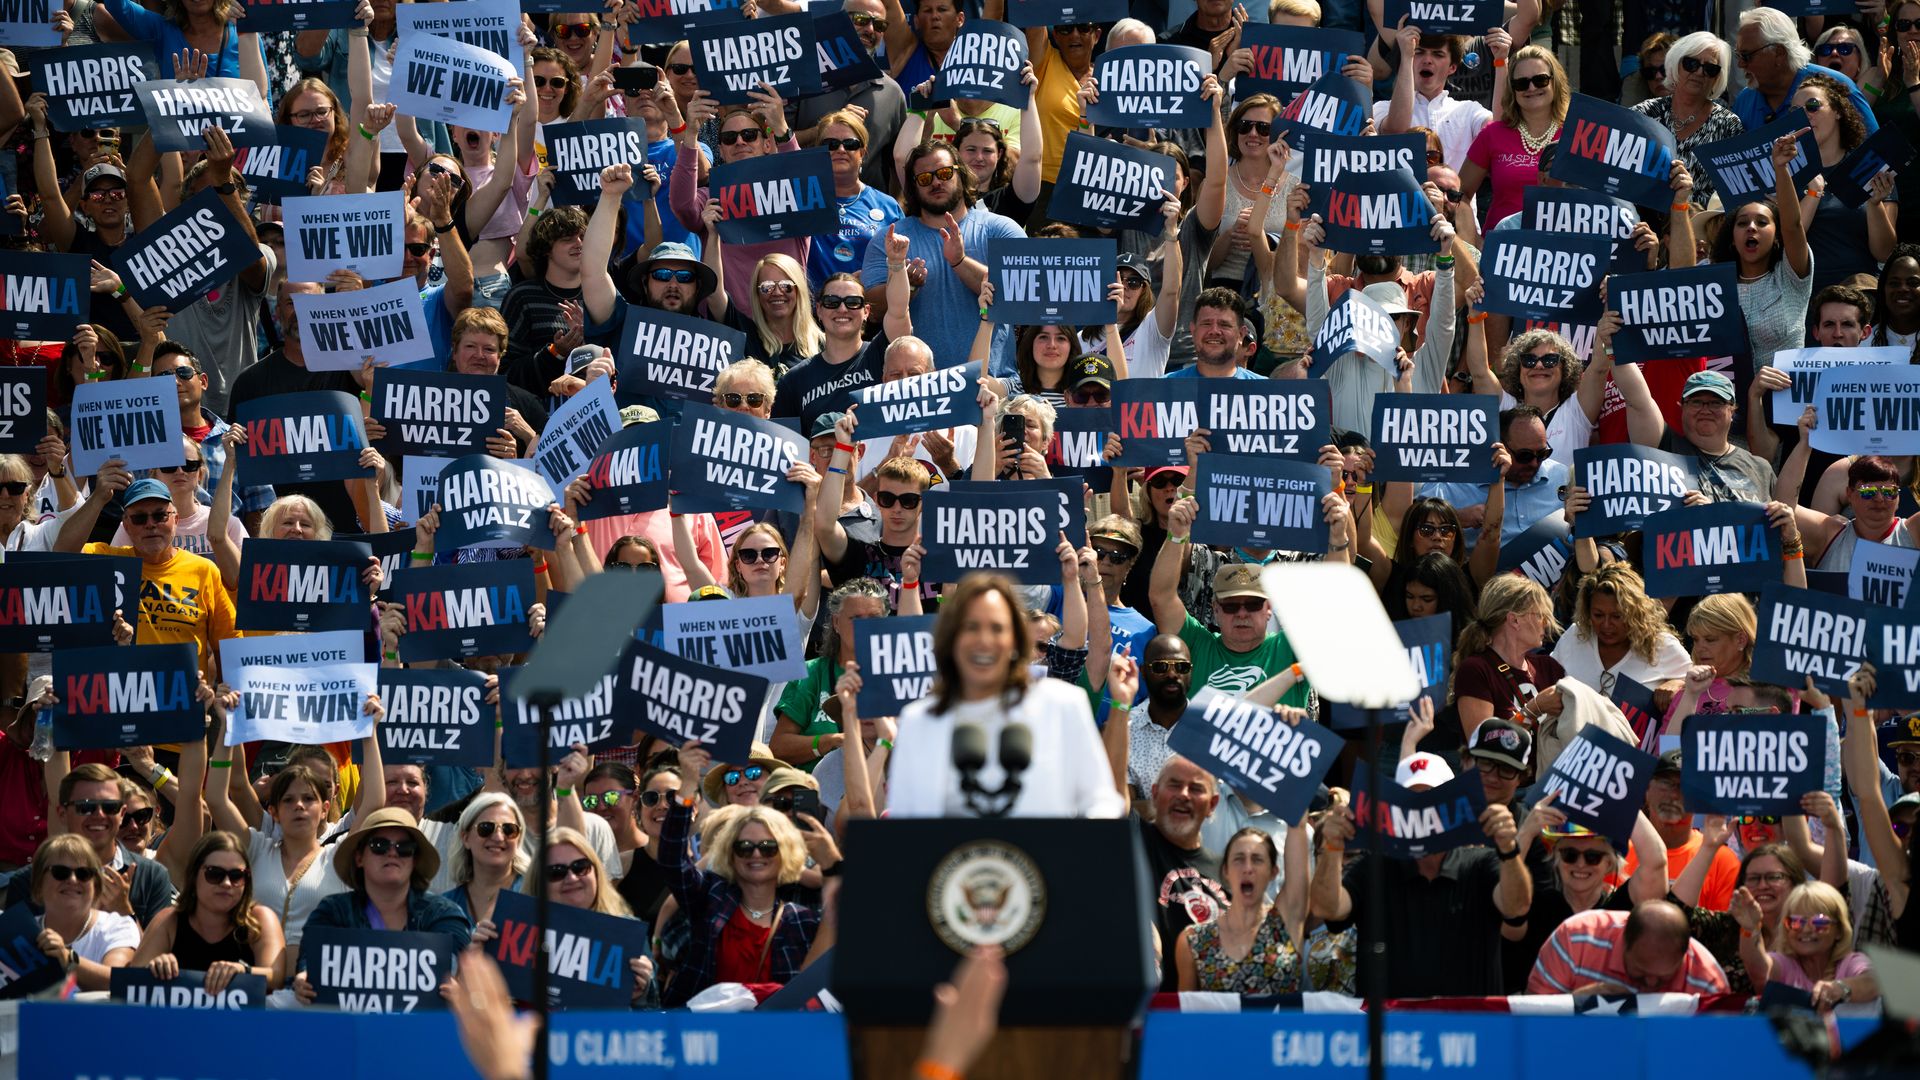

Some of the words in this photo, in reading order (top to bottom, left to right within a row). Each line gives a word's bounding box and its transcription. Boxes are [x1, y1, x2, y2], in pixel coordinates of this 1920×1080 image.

[413, 19, 449, 30] WHEN
[452, 18, 471, 28] WE
[474, 16, 504, 27] VOTE
[1411, 2, 1475, 22] WALZ
[414, 49, 448, 64] WHEN
[449, 56, 471, 70] WE
[474, 62, 504, 76] VOTE
[702, 26, 802, 72] HARRIS
[940, 32, 1021, 72] HARRIS
[44, 56, 146, 97] HARRIS
[406, 61, 451, 96] WE
[452, 71, 504, 111] WIN
[724, 65, 791, 92] WALZ
[945, 66, 1004, 90] WALZ
[1100, 59, 1200, 92] HARRIS
[66, 94, 135, 117] WALZ
[151, 87, 254, 116] HARRIS
[1117, 96, 1184, 114] WALZ
[554, 130, 642, 172] HARRIS
[1314, 148, 1414, 183] HARRIS
[1569, 118, 1670, 180] KAMALA
[1711, 150, 1739, 166] WHEN
[1740, 142, 1765, 157] WE
[572, 172, 601, 191] WA
[1072, 150, 1164, 201] HARRIS
[1717, 160, 1752, 196] WE
[302, 211, 340, 224] WHEN
[343, 210, 362, 222] WE
[364, 209, 391, 222] VOTE
[719, 174, 826, 222] KAMALA
[1082, 190, 1146, 217] WALZ
[1328, 190, 1428, 230] KAMALA
[1536, 201, 1634, 239] HARRIS
[126, 208, 226, 291] HARRIS
[300, 228, 341, 260] WE
[345, 222, 393, 257] WIN
[160, 247, 228, 300] WALZ
[1002, 256, 1040, 266] WHEN
[1042, 256, 1062, 266] WE
[1064, 256, 1101, 266] FIGHT
[1494, 242, 1596, 289] HARRIS
[0, 274, 80, 316] MALA
[1001, 269, 1040, 302] WE
[1046, 269, 1101, 302] WIN
[1508, 282, 1575, 309] WALZ
[1620, 282, 1726, 326] HARRIS
[309, 307, 346, 320] WHEN
[348, 305, 371, 318] WE
[373, 298, 404, 313] VOTE
[1317, 299, 1395, 350] HARRIS
[310, 322, 353, 352] WE
[356, 311, 414, 350] WIN
[633, 322, 732, 372] HARRIS
[1326, 326, 1383, 353] WALZ
[1642, 324, 1712, 346] WALZ
[646, 362, 717, 393] WALZ
[1792, 360, 1827, 368] WHEN
[862, 364, 967, 404] HARRIS
[1831, 384, 1867, 394] WHEN
[1870, 384, 1892, 393] WE
[77, 399, 102, 413] WHEN
[104, 398, 123, 410] WE
[125, 395, 160, 408] VOTE
[384, 384, 491, 425] HARRIS
[881, 397, 952, 424] WALZ
[1121, 401, 1199, 440] KAMA
[1209, 394, 1316, 430] HARRIS
[1826, 398, 1866, 431] WE
[76, 416, 105, 451] WE
[108, 410, 168, 448] WIN
[248, 414, 362, 458] KAMALA
[400, 424, 472, 446] WALZ
[538, 426, 564, 452] WHEN
[562, 415, 579, 430] WE
[576, 398, 601, 418] VOTE
[692, 418, 798, 469] HARRIS
[1227, 434, 1300, 454] WALZ
[1381, 408, 1488, 446] HARRIS
[539, 438, 580, 485] WE
[588, 444, 662, 490] KAMALA
[1398, 448, 1470, 468] WALZ
[444, 468, 546, 513] HARRIS
[706, 461, 775, 496] WALZ
[1210, 474, 1250, 487] WHEN
[1253, 476, 1276, 488] WE
[1277, 478, 1316, 492] FIGHT
[1587, 458, 1688, 497] HARRIS
[463, 509, 532, 530] WALZ
[936, 507, 1047, 546] HARRIS
[1208, 488, 1250, 524] WE
[1256, 491, 1316, 530] WIN
[955, 548, 1030, 569] WALZ
[1656, 525, 1770, 570] KAMALA
[251, 563, 360, 603] KAMALA
[1866, 562, 1906, 577] WHEN
[405, 584, 527, 633] KAMALA
[679, 622, 716, 634] WHEN
[718, 619, 740, 630] WE
[742, 615, 777, 628] VOTE
[726, 629, 788, 668] WIN
[1770, 602, 1867, 658] HARRI
[240, 654, 282, 667] WHEN
[286, 652, 308, 664] WE
[312, 650, 346, 662] VOTE
[1784, 649, 1861, 682] WALZ
[67, 670, 191, 715] KAMALA
[248, 680, 292, 690] WHEN
[294, 682, 318, 692] WE
[320, 679, 356, 690] VOTE
[631, 656, 747, 725] HARRIS
[244, 692, 288, 720] WE
[299, 692, 358, 724] WIN
[647, 700, 721, 744] WALZ
[386, 728, 460, 750] WALZ
[1202, 694, 1322, 778] HARRIS
[1696, 730, 1809, 773] HARRIS
[1208, 733, 1287, 794] WALZ
[1552, 734, 1635, 801] HARRIS
[1547, 773, 1605, 818] WALZ
[1714, 776, 1790, 800] WALZ
[322, 944, 437, 992] HARRIS
[338, 992, 419, 1014] WALZ
[574, 1031, 676, 1068] CLAIRE,
[682, 1031, 719, 1066] WI
[1271, 1030, 1325, 1068] EAU
[1440, 1032, 1477, 1067] WI
